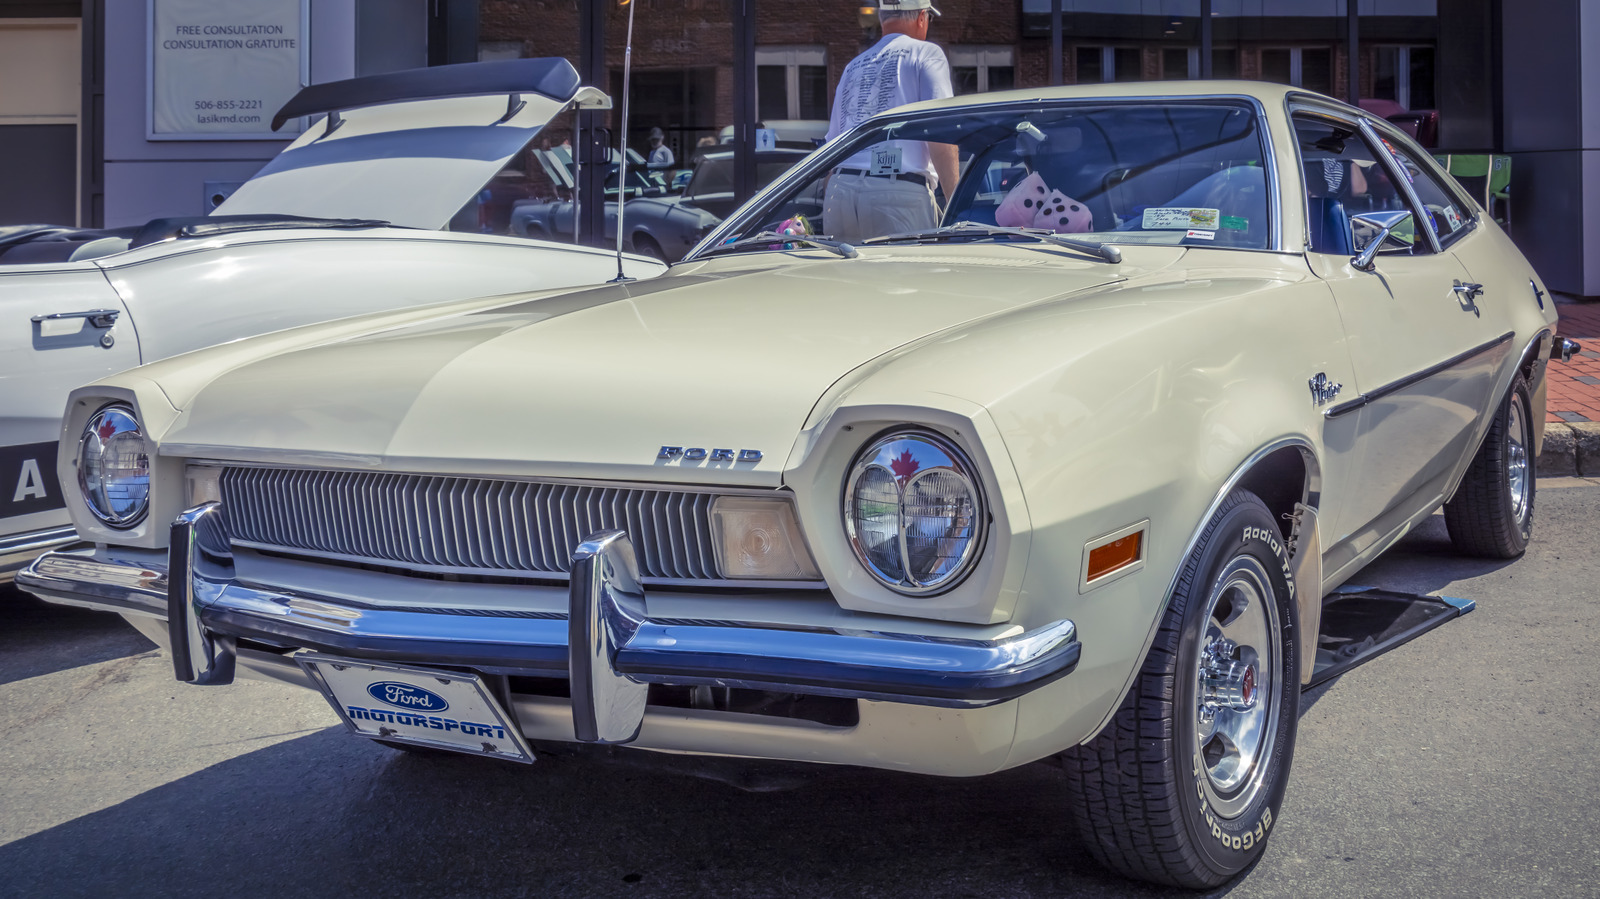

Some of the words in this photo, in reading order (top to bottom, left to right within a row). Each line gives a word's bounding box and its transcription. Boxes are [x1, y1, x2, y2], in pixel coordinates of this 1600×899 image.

[176, 25, 201, 36] FREE
[203, 24, 284, 36] CONSULTATION
[163, 39, 243, 50] CONSULTATION
[245, 38, 296, 49] GRATUITE
[194, 100, 263, 110] 506-855-2221
[197, 114, 261, 124] lasikmd.com
[656, 445, 765, 463] FORD
[12, 458, 48, 502] A
[1242, 526, 1283, 558] Radial
[384, 684, 434, 709] Ford
[347, 704, 506, 740] MOTORSPORT
[1193, 753, 1273, 850] BFGoodrich
